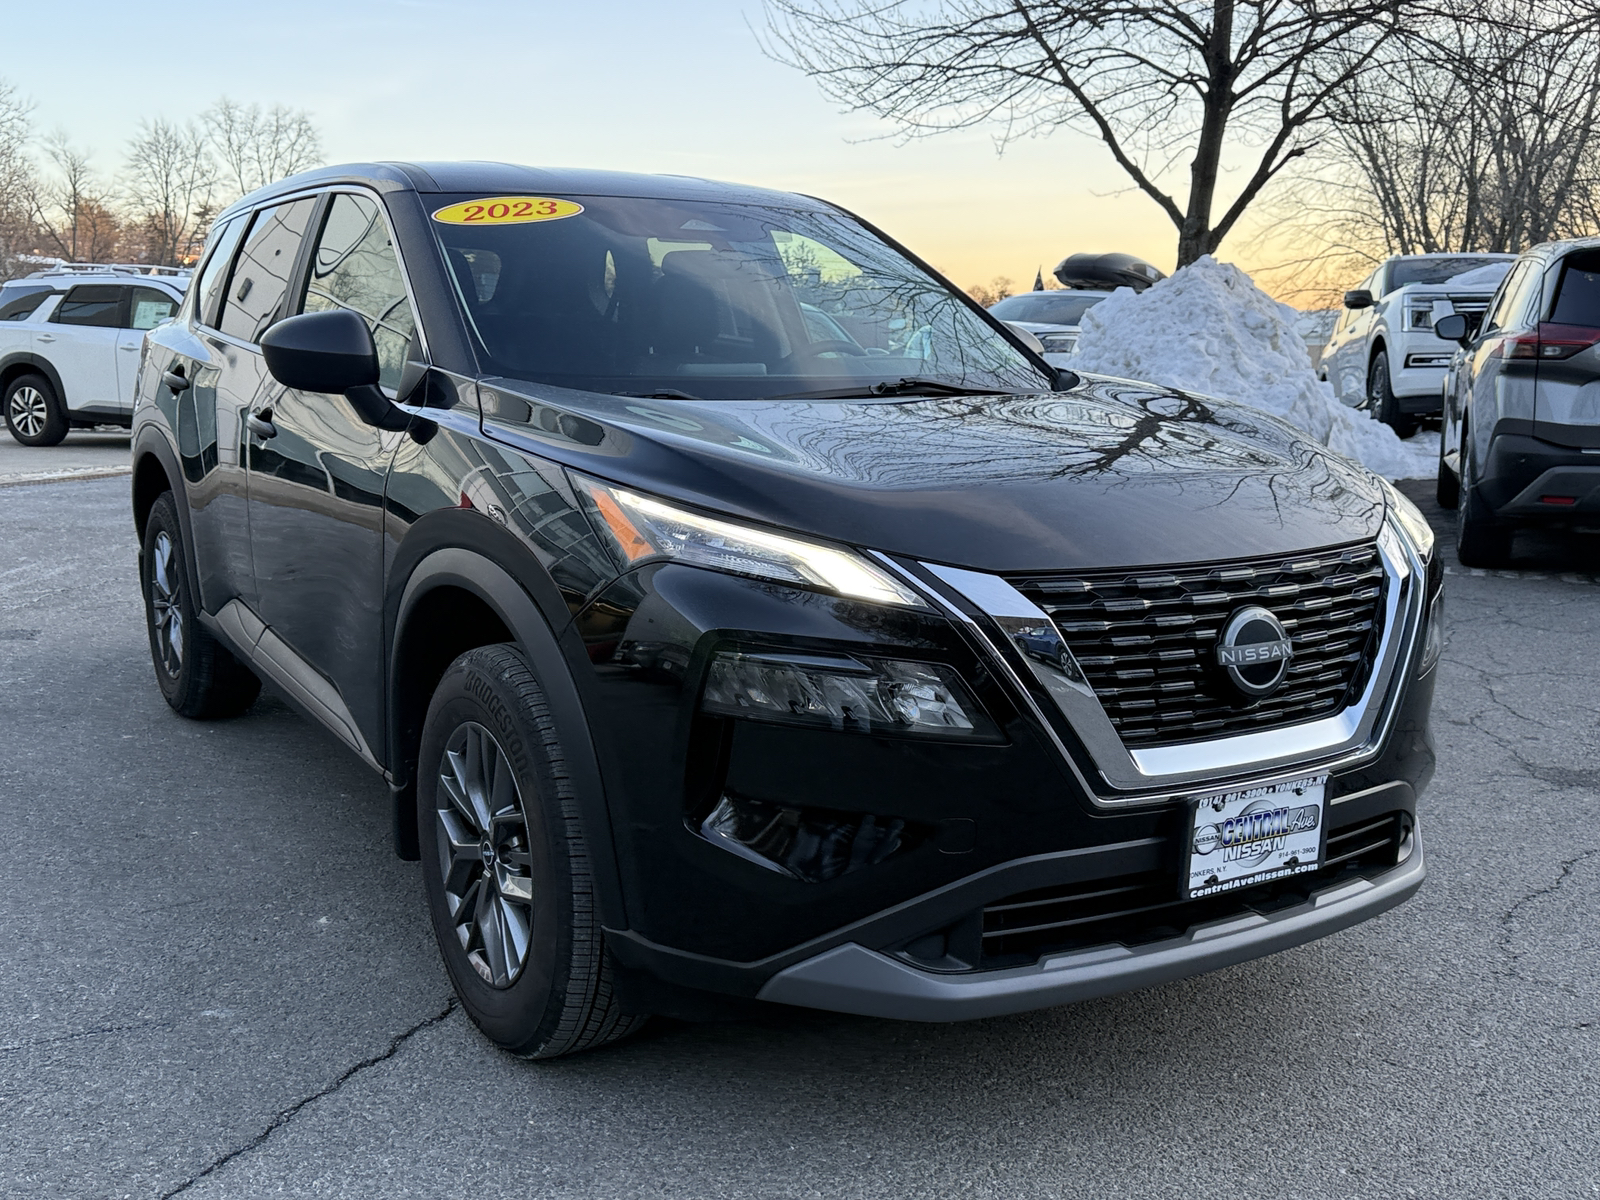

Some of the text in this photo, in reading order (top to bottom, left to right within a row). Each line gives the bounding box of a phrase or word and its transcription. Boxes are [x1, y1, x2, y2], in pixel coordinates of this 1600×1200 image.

[463, 201, 558, 222] 2023
[1221, 642, 1292, 663] NISSAN
[463, 670, 531, 786] BRIDGESTONE
[1195, 834, 1220, 843] NISSAN
[1221, 806, 1290, 847] CENTRAL
[1223, 836, 1287, 863] NISSAN
[1278, 846, 1316, 858] 914-961-3900
[1190, 862, 1318, 899] CentralAveNissan.com
